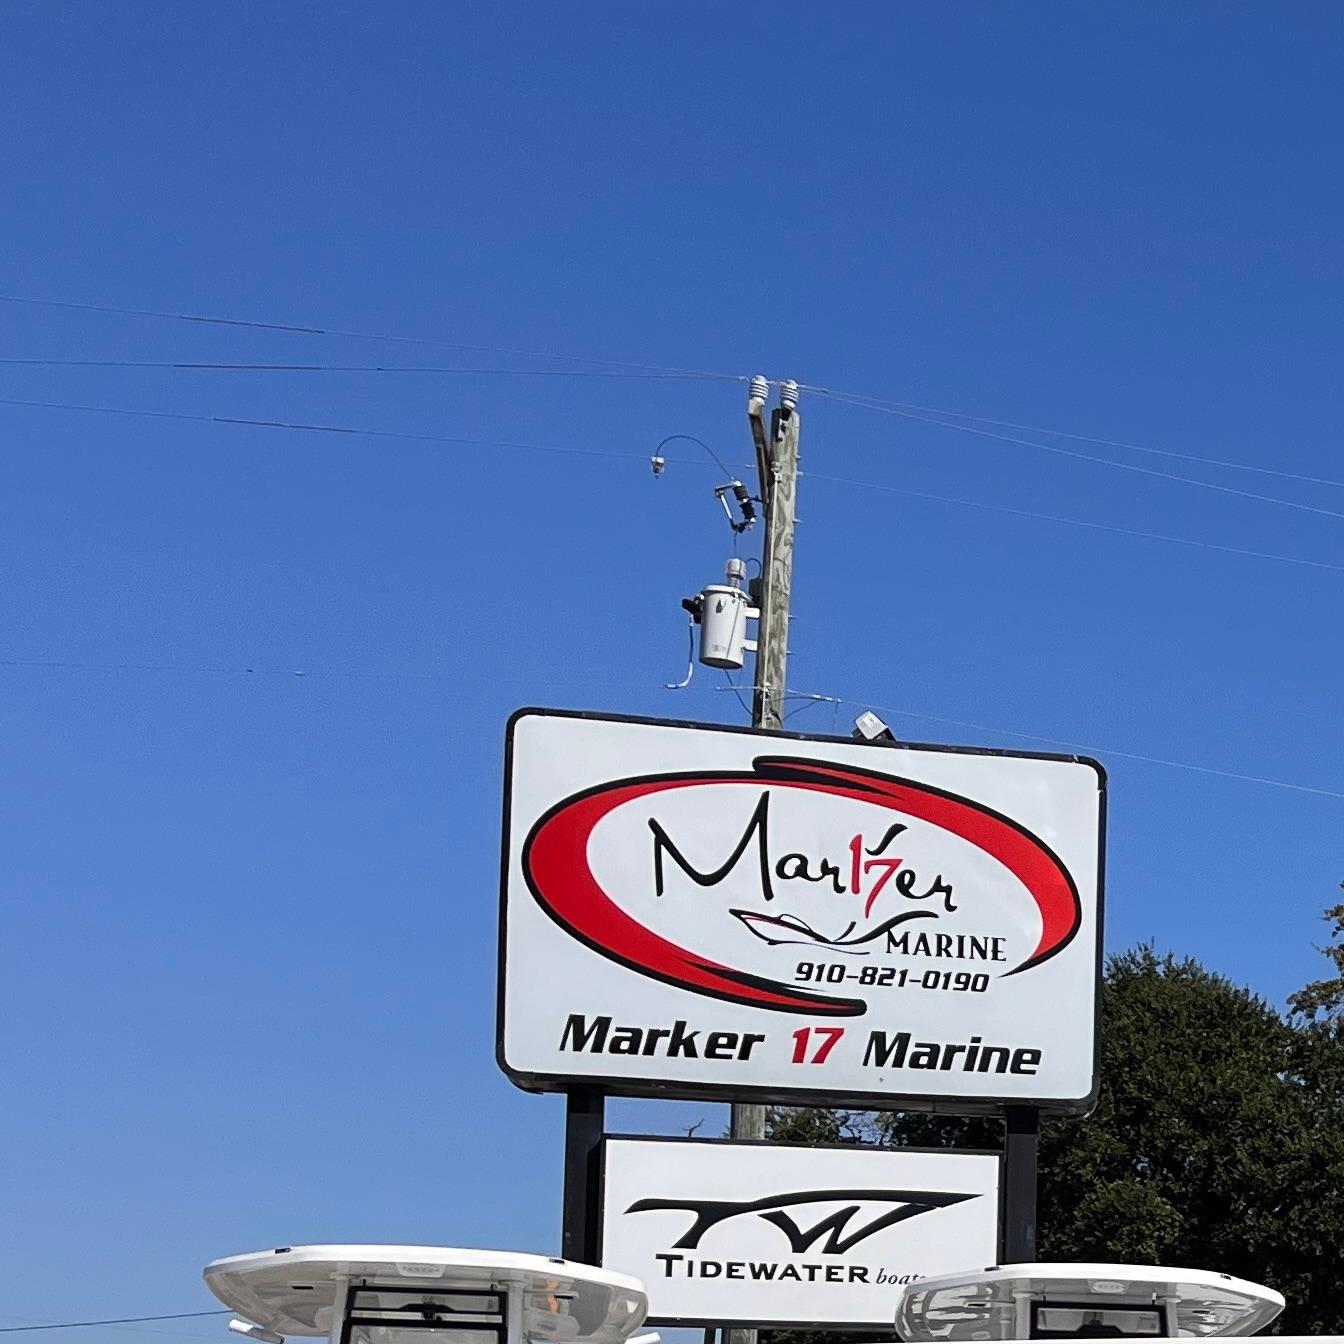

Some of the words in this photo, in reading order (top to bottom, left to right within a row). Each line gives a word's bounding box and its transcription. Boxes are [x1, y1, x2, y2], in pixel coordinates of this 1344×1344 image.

[886, 929, 1007, 962] MARINE
[795, 962, 990, 993] 910-821-0190
[559, 1014, 765, 1062] Marker
[792, 1027, 845, 1064] 17
[862, 1030, 1042, 1076] Marine
[655, 1253, 870, 1285] TIDEWATER
